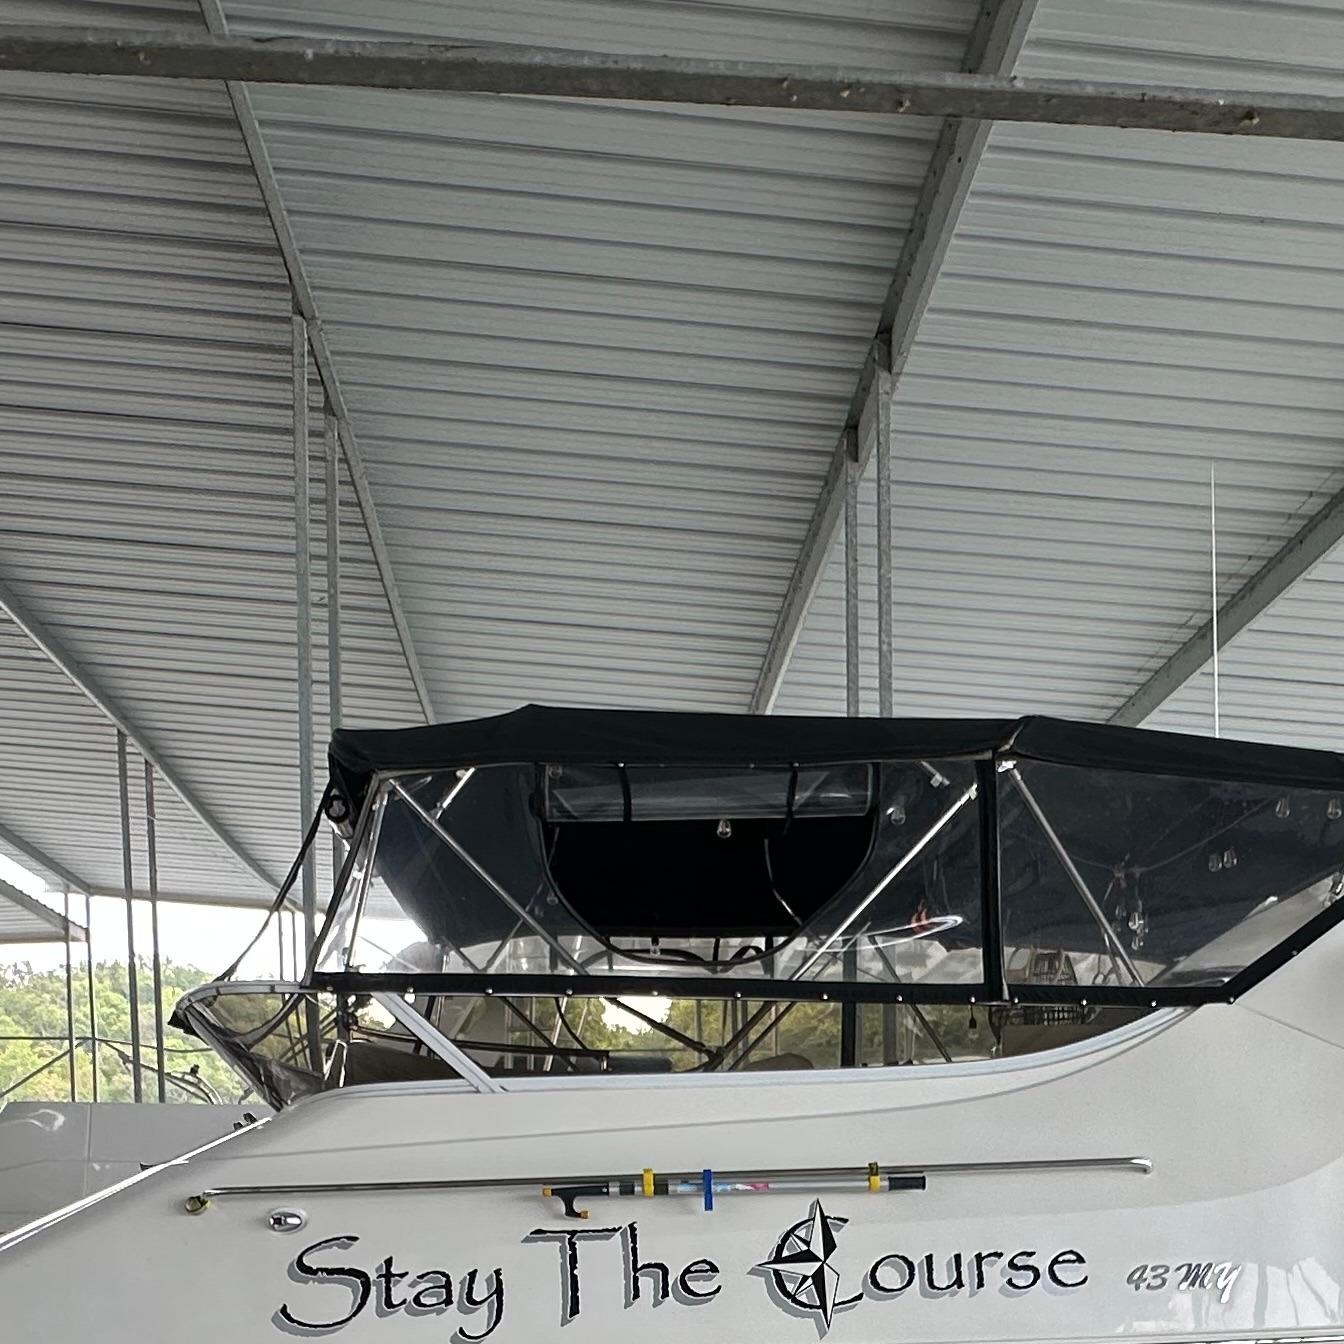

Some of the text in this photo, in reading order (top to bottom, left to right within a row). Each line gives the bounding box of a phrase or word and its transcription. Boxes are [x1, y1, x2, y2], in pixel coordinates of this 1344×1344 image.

[521, 1221, 722, 1327] The
[759, 1210, 1089, 1322] Course
[1126, 1261, 1242, 1304] 43 MY
